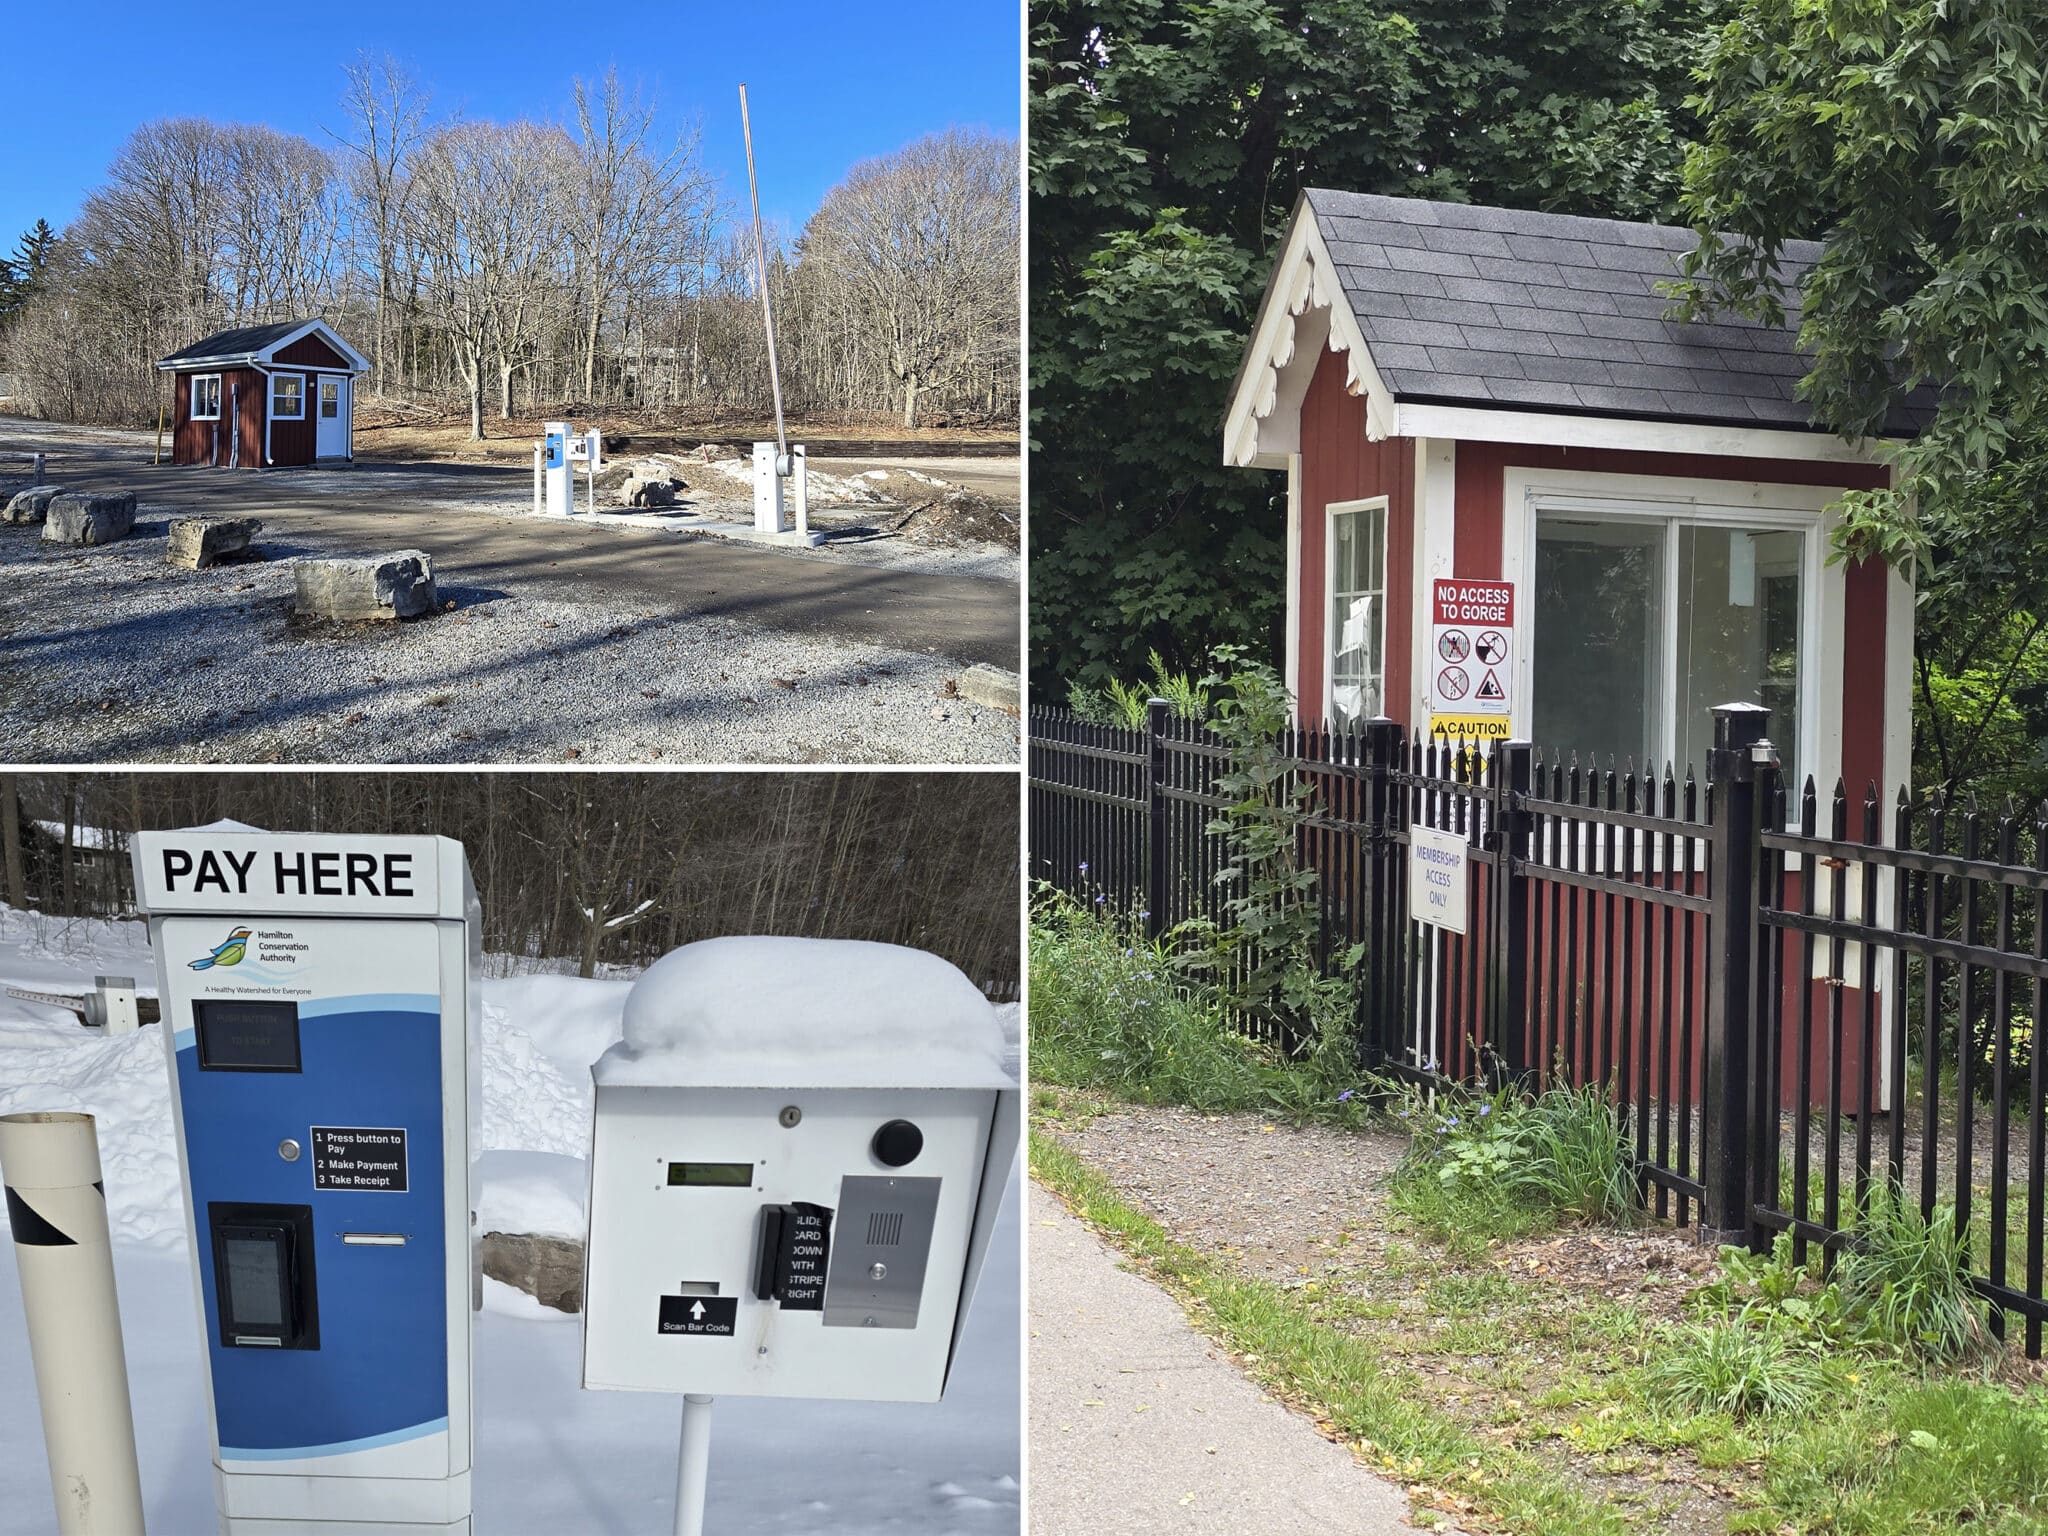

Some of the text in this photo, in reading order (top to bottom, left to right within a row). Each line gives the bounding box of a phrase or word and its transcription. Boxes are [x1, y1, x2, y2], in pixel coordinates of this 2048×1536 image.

[1438, 586, 1510, 606] NO ACCESS
[1441, 603, 1507, 622] TO GORGE
[1447, 721, 1507, 736] CAUTION
[1416, 845, 1461, 869] MEMBERSHIP
[162, 848, 414, 897] PAY HERE
[1425, 868, 1451, 888] ACCESS
[1429, 890, 1447, 908] ONLY
[257, 931, 293, 939] Hamilton
[259, 942, 309, 951] Conservation
[260, 953, 296, 963] Authority
[211, 986, 235, 995] Healthy
[236, 986, 271, 994] Watershed
[282, 987, 312, 996] Everyone
[316, 1133, 401, 1144] 1 Press button to
[327, 1144, 345, 1155] Pay
[317, 1159, 398, 1171] 2 Make Payment
[319, 1175, 390, 1187] 3 Take Receipt
[663, 1322, 730, 1333] Scan Bar Code
